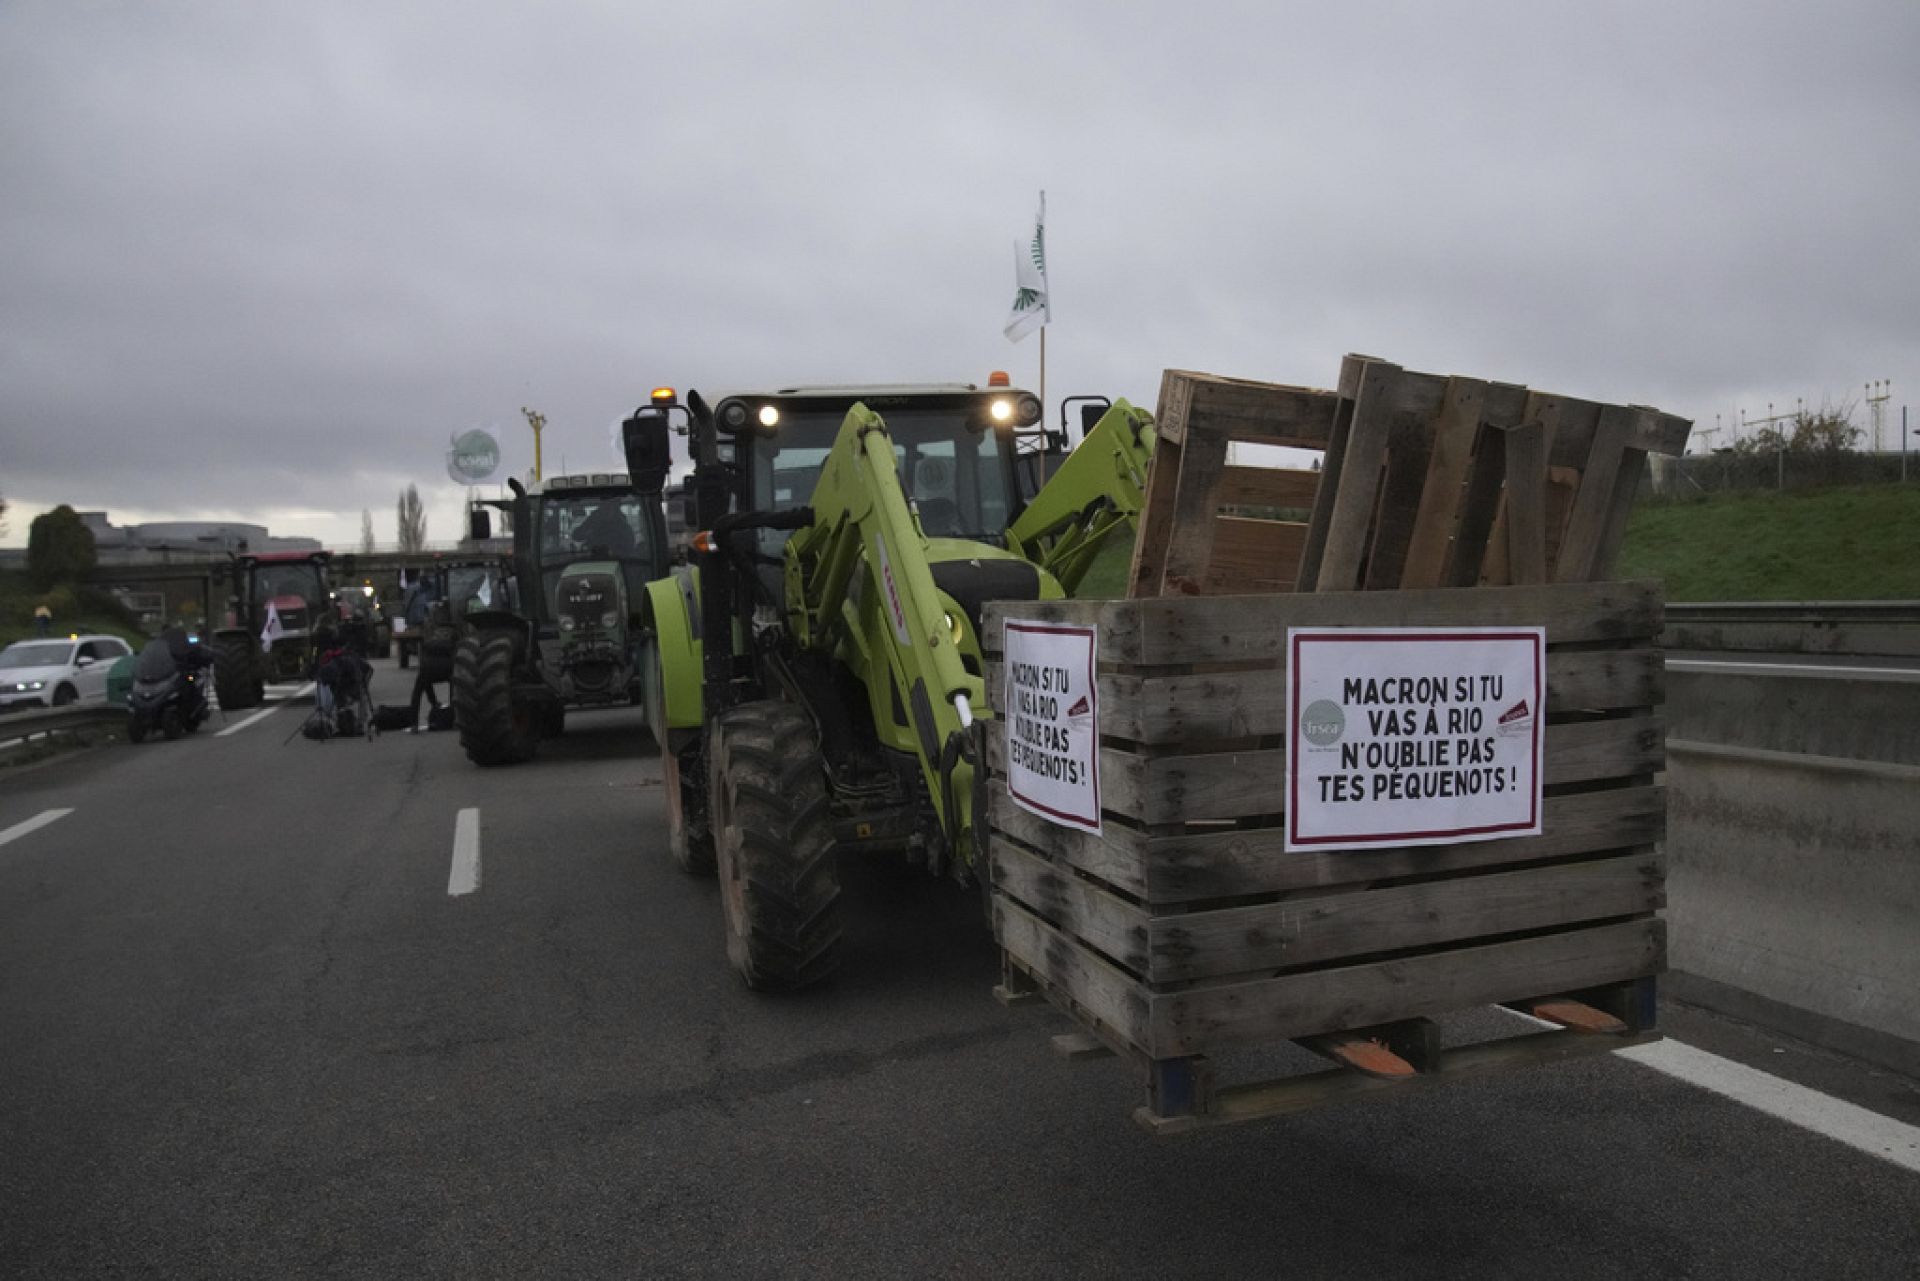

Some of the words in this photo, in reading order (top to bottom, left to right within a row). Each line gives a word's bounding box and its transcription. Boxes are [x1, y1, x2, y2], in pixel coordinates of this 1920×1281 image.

[1042, 666, 1053, 692] SI
[1055, 667, 1070, 694] TU
[1343, 676, 1448, 705] MACRON
[1454, 675, 1475, 702] SI
[1480, 674, 1503, 702] TU
[1040, 695, 1058, 721] RIO
[1367, 708, 1417, 736] VAS
[1423, 700, 1439, 735] À
[1448, 706, 1483, 734] RIO
[1044, 725, 1070, 753] PAS
[1341, 739, 1449, 769] N'OUBLIE
[1456, 736, 1496, 766] PAS
[1318, 774, 1365, 802] TES
[1372, 764, 1505, 801] PÉQUENOTS
